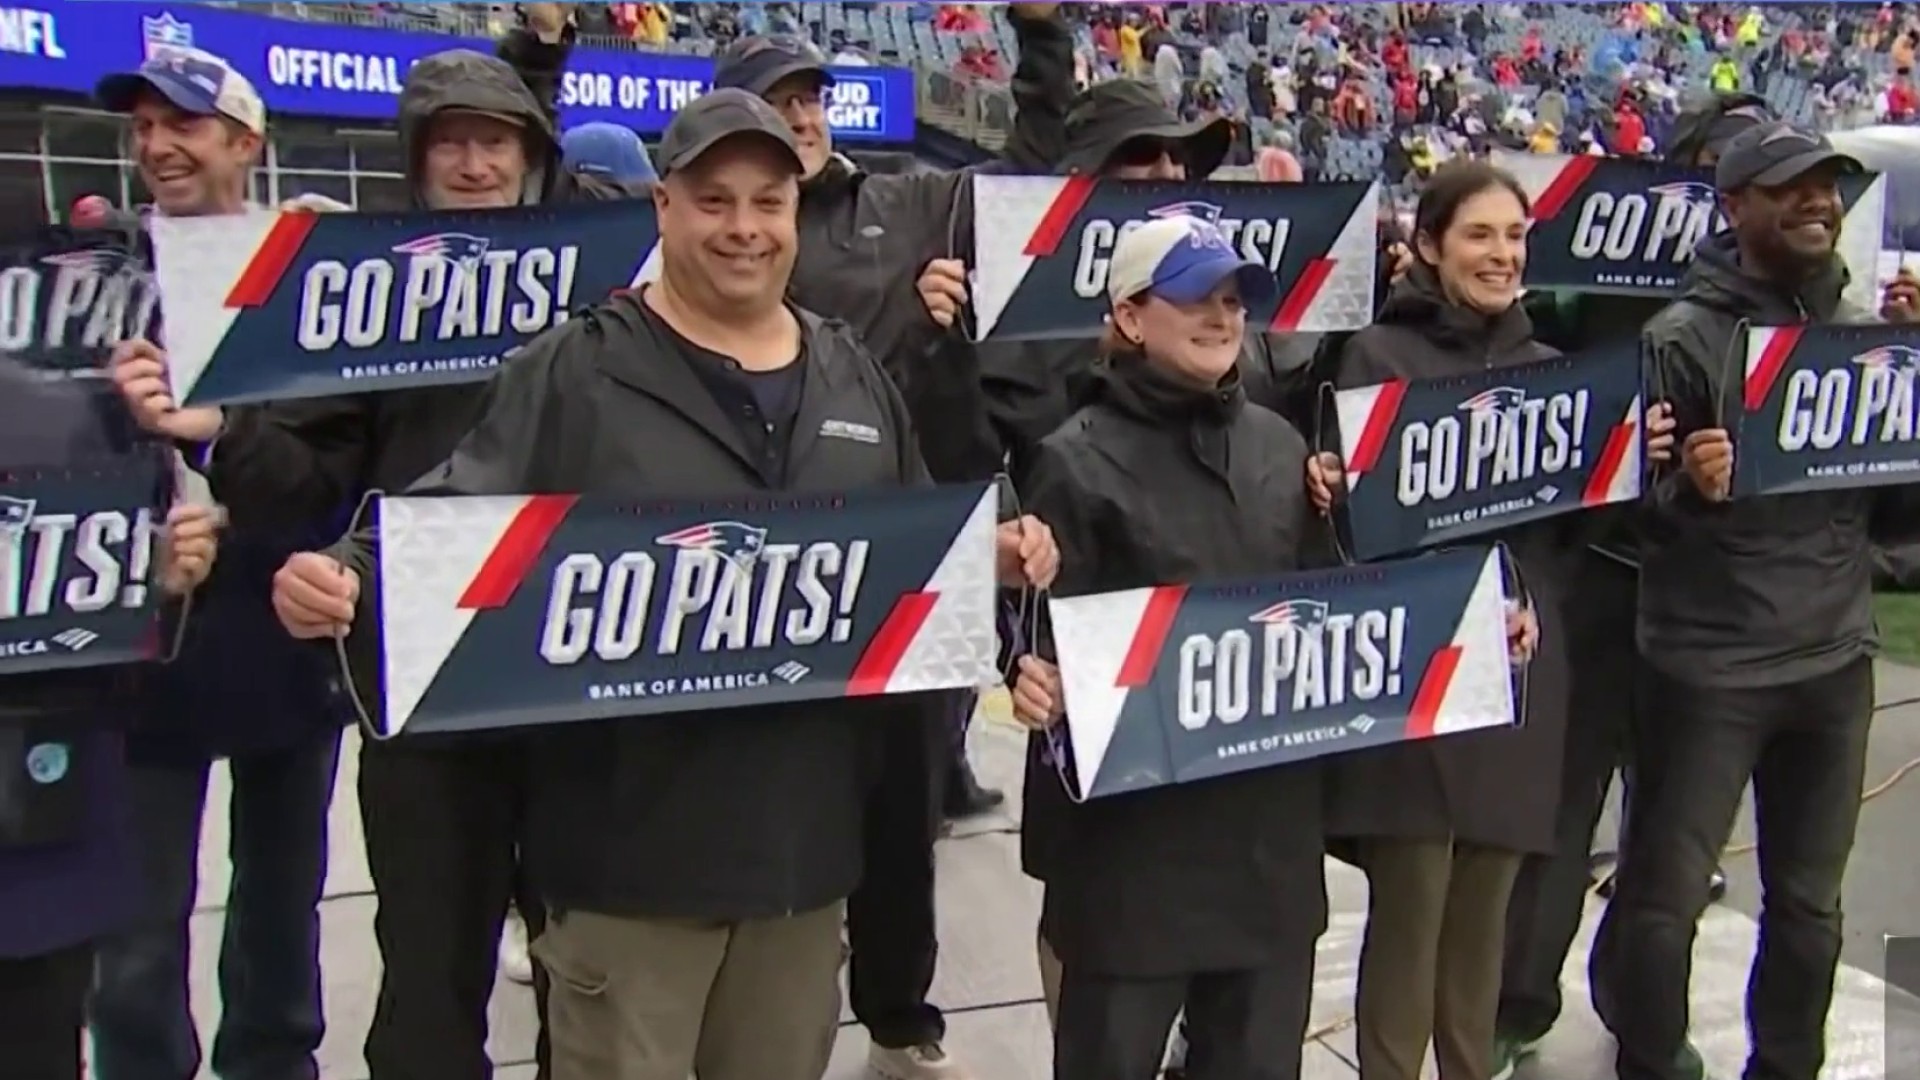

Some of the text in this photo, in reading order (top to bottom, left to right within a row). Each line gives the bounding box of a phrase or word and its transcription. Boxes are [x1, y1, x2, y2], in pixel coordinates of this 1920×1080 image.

[0, 8, 66, 58] NFL
[268, 46, 703, 112] OFFICIAL SOR OF THE
[832, 82, 870, 104] UD
[828, 106, 881, 128] GHT
[1571, 192, 1728, 262] GO PA
[0, 267, 40, 349] O
[298, 245, 578, 350] GO PATS!
[342, 355, 499, 379] BANK OF AMERICA
[1778, 362, 1920, 451] GO PA
[1398, 389, 1588, 506] GO PATS!
[540, 540, 870, 664] GO PATS!
[589, 673, 769, 700] BANK OF AMERICA
[1178, 607, 1406, 730] GO PATS!
[1218, 726, 1347, 758] BANK OF AMERICA
